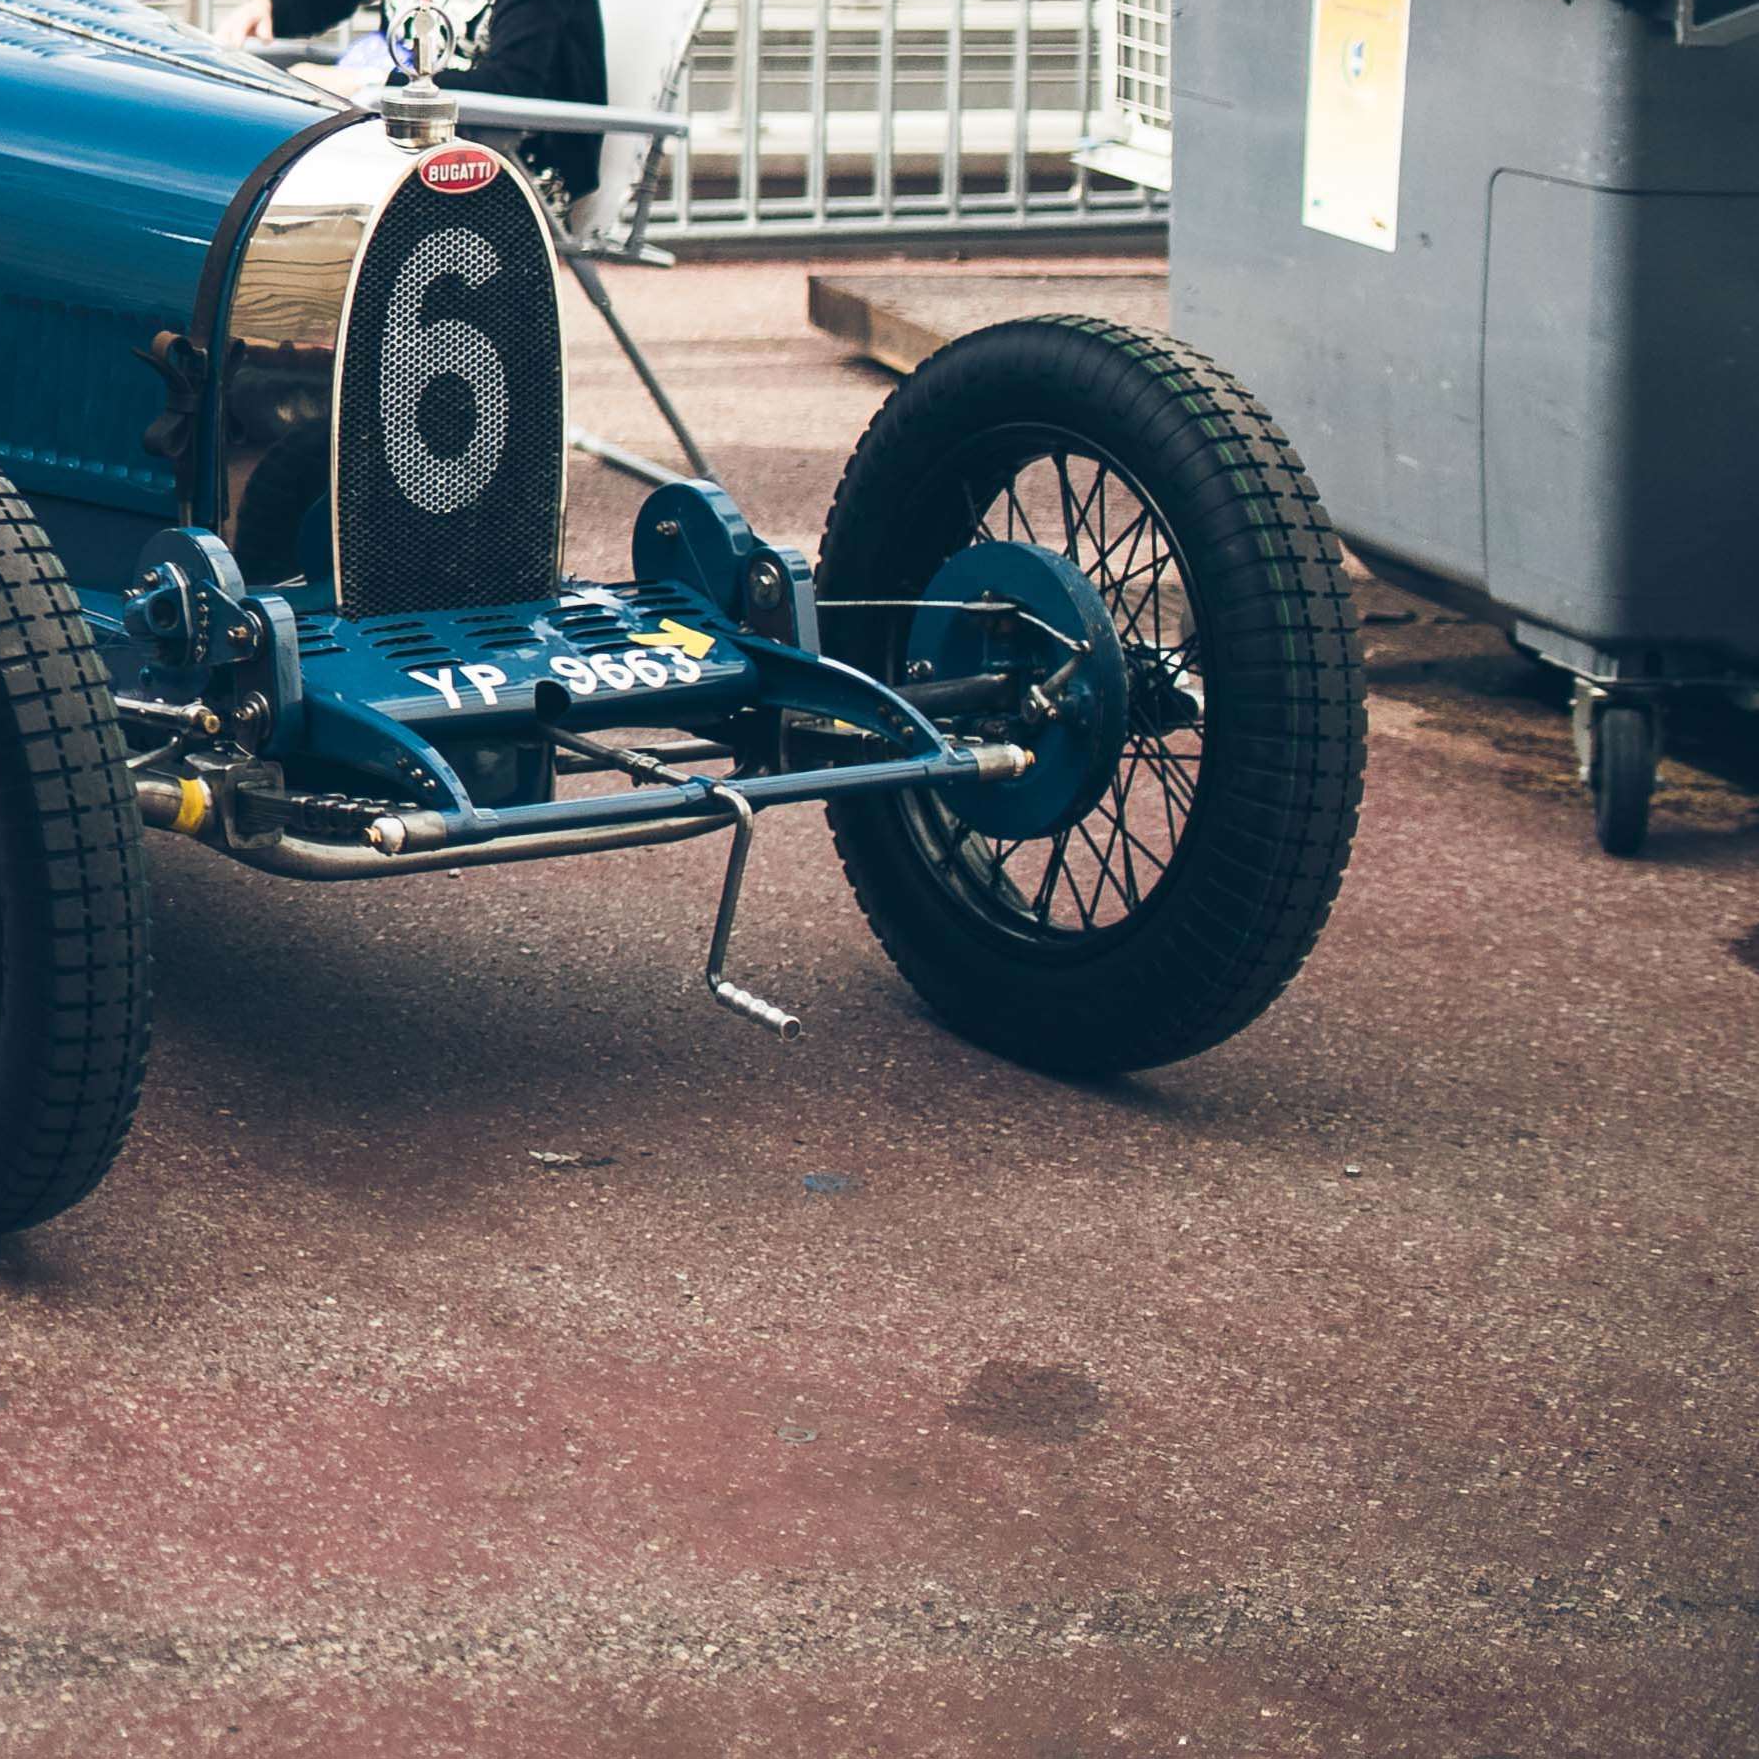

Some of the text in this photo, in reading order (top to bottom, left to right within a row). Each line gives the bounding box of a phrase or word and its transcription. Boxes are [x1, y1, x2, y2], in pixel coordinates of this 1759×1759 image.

[428, 160, 491, 182] BUGATTI
[380, 227, 510, 515] 6
[407, 645, 702, 710] YP 9663
